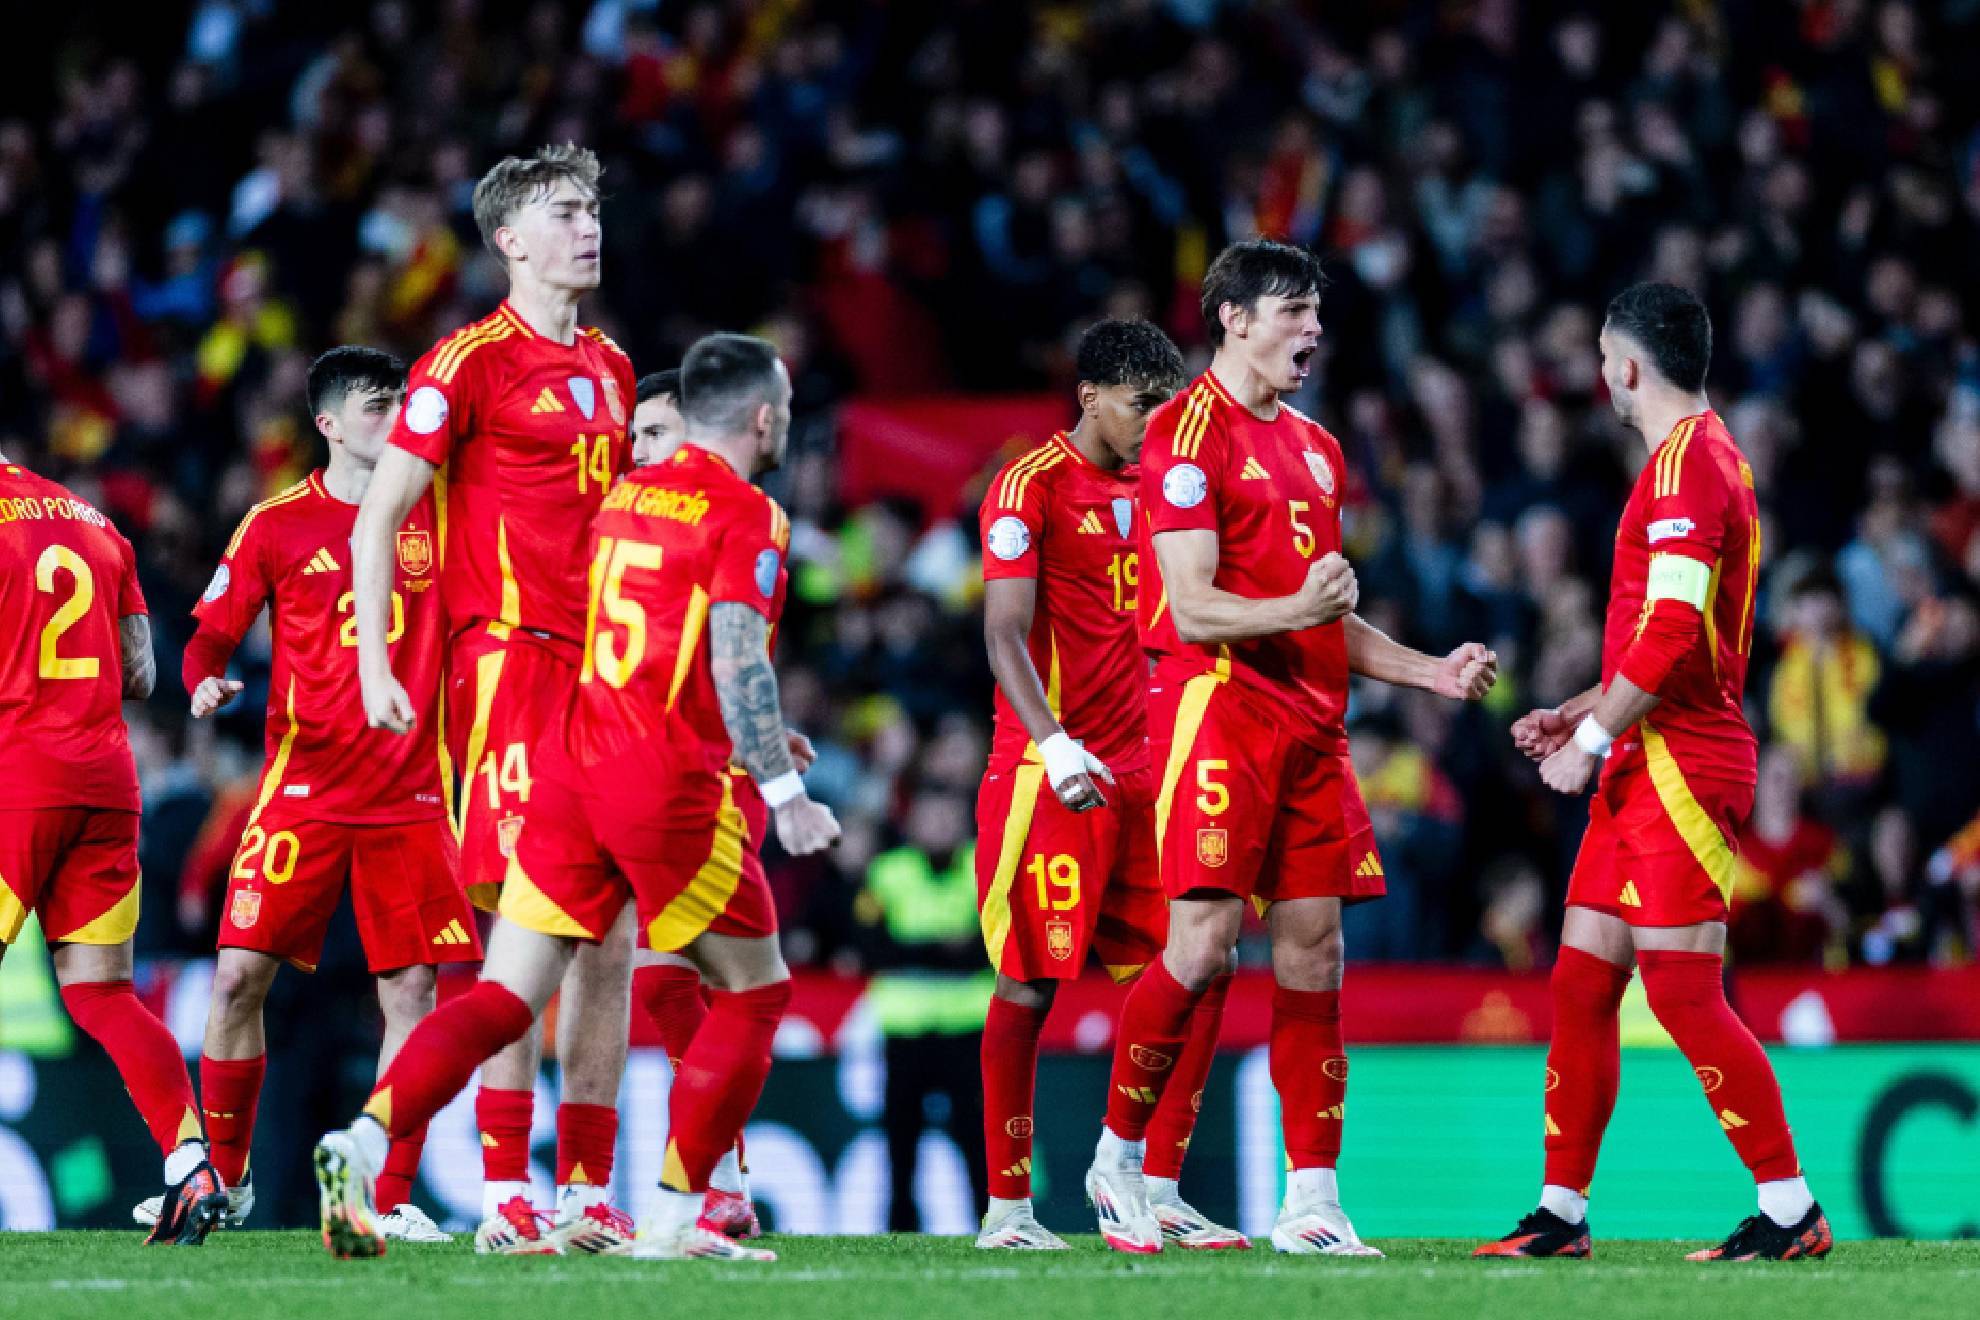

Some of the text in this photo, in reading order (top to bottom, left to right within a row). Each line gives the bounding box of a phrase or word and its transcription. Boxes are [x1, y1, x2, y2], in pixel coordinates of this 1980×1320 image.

[569, 433, 611, 495] 14
[0, 498, 41, 524] DRO
[1289, 499, 1315, 558] 5
[1107, 552, 1139, 611] 19
[35, 544, 100, 679] 2
[579, 536, 662, 689] 15
[479, 742, 532, 808] 14
[1196, 759, 1230, 816] 5
[233, 825, 300, 884] 20
[1026, 853, 1081, 911] 19
